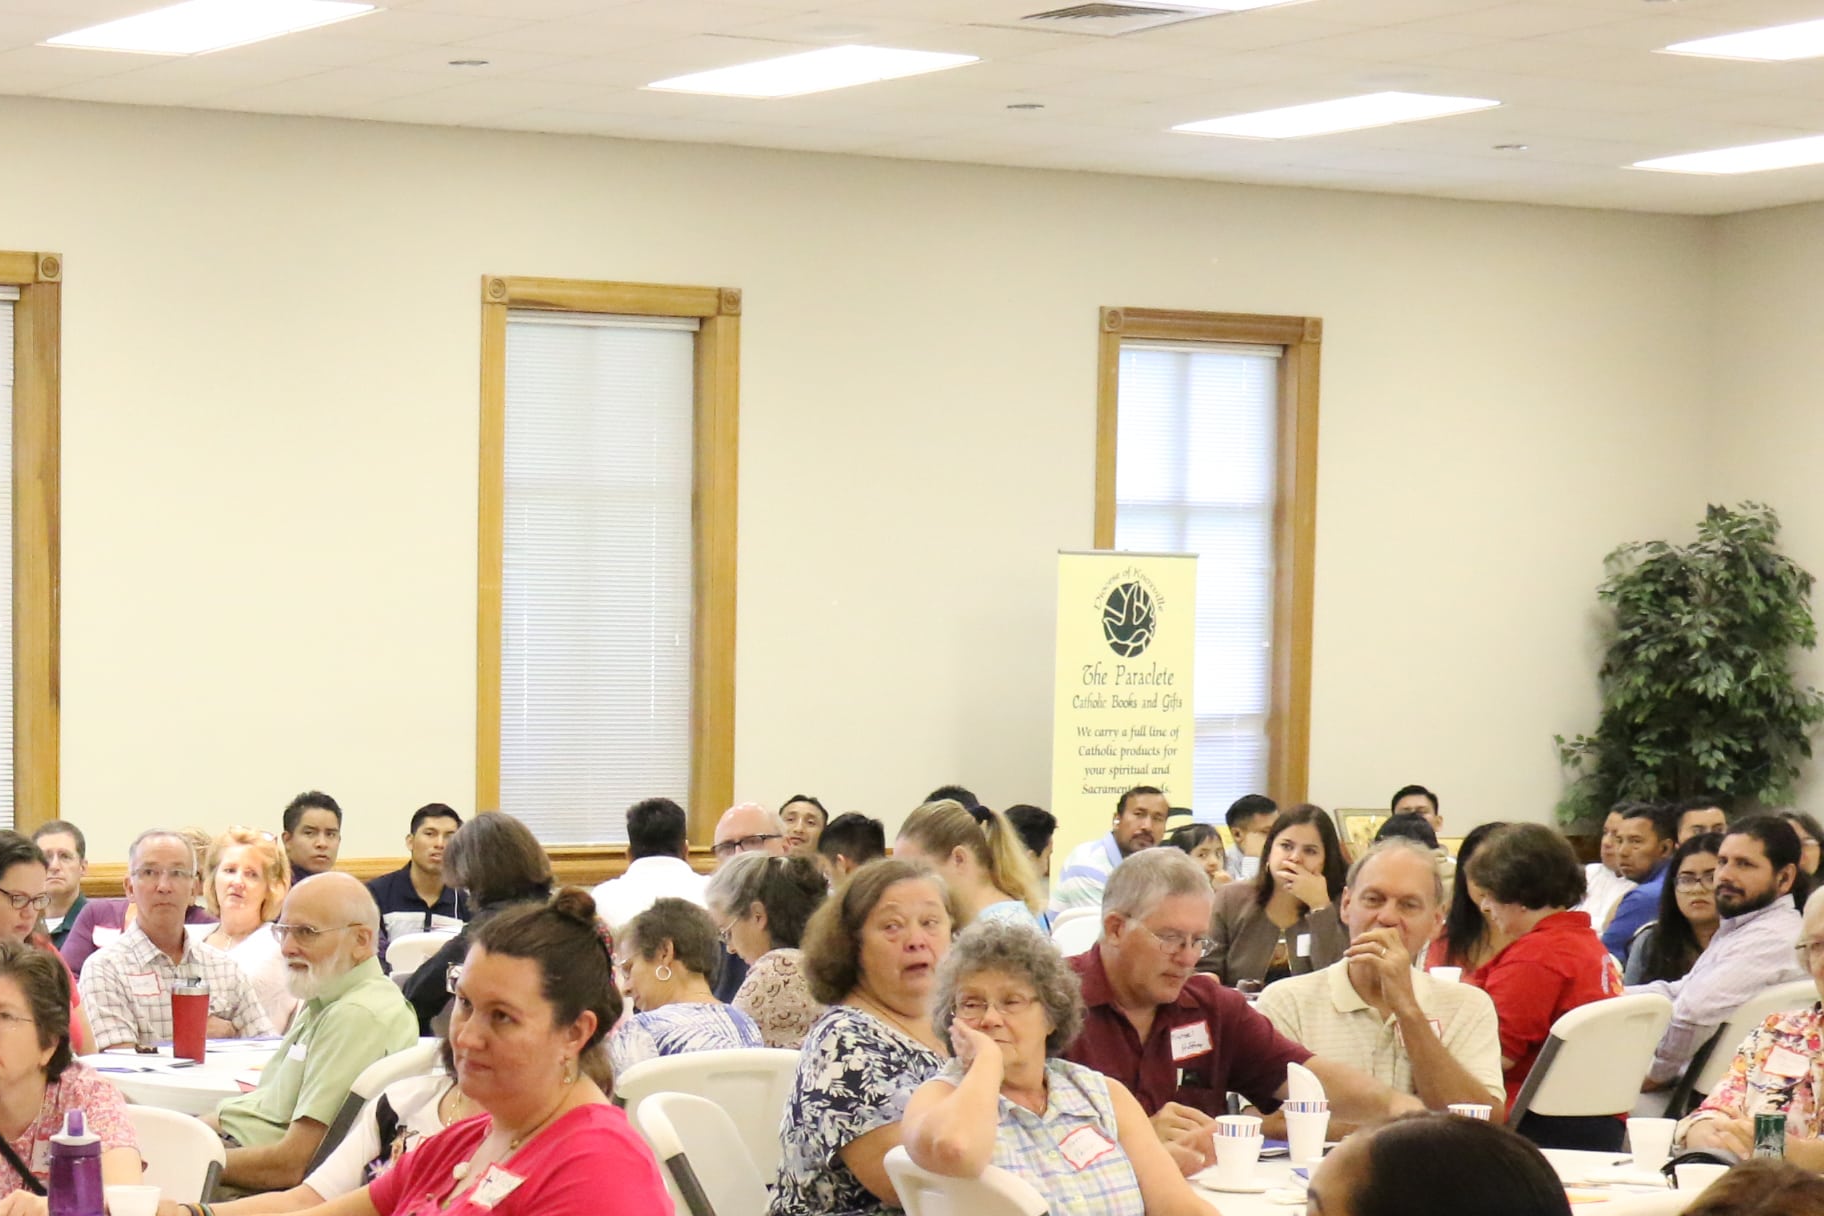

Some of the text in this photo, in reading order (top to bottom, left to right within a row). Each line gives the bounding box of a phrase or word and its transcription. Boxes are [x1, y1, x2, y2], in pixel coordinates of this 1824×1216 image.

[1094, 565, 1165, 611] Diocese of Knoxville
[1082, 661, 1174, 686] The Paraclete
[1072, 692, 1183, 712] Catholic Books and Gifts
[1077, 725, 1180, 742] We carry a full line of
[1078, 744, 1178, 761] Catholic products for
[1082, 764, 1170, 780] your spiritual and
